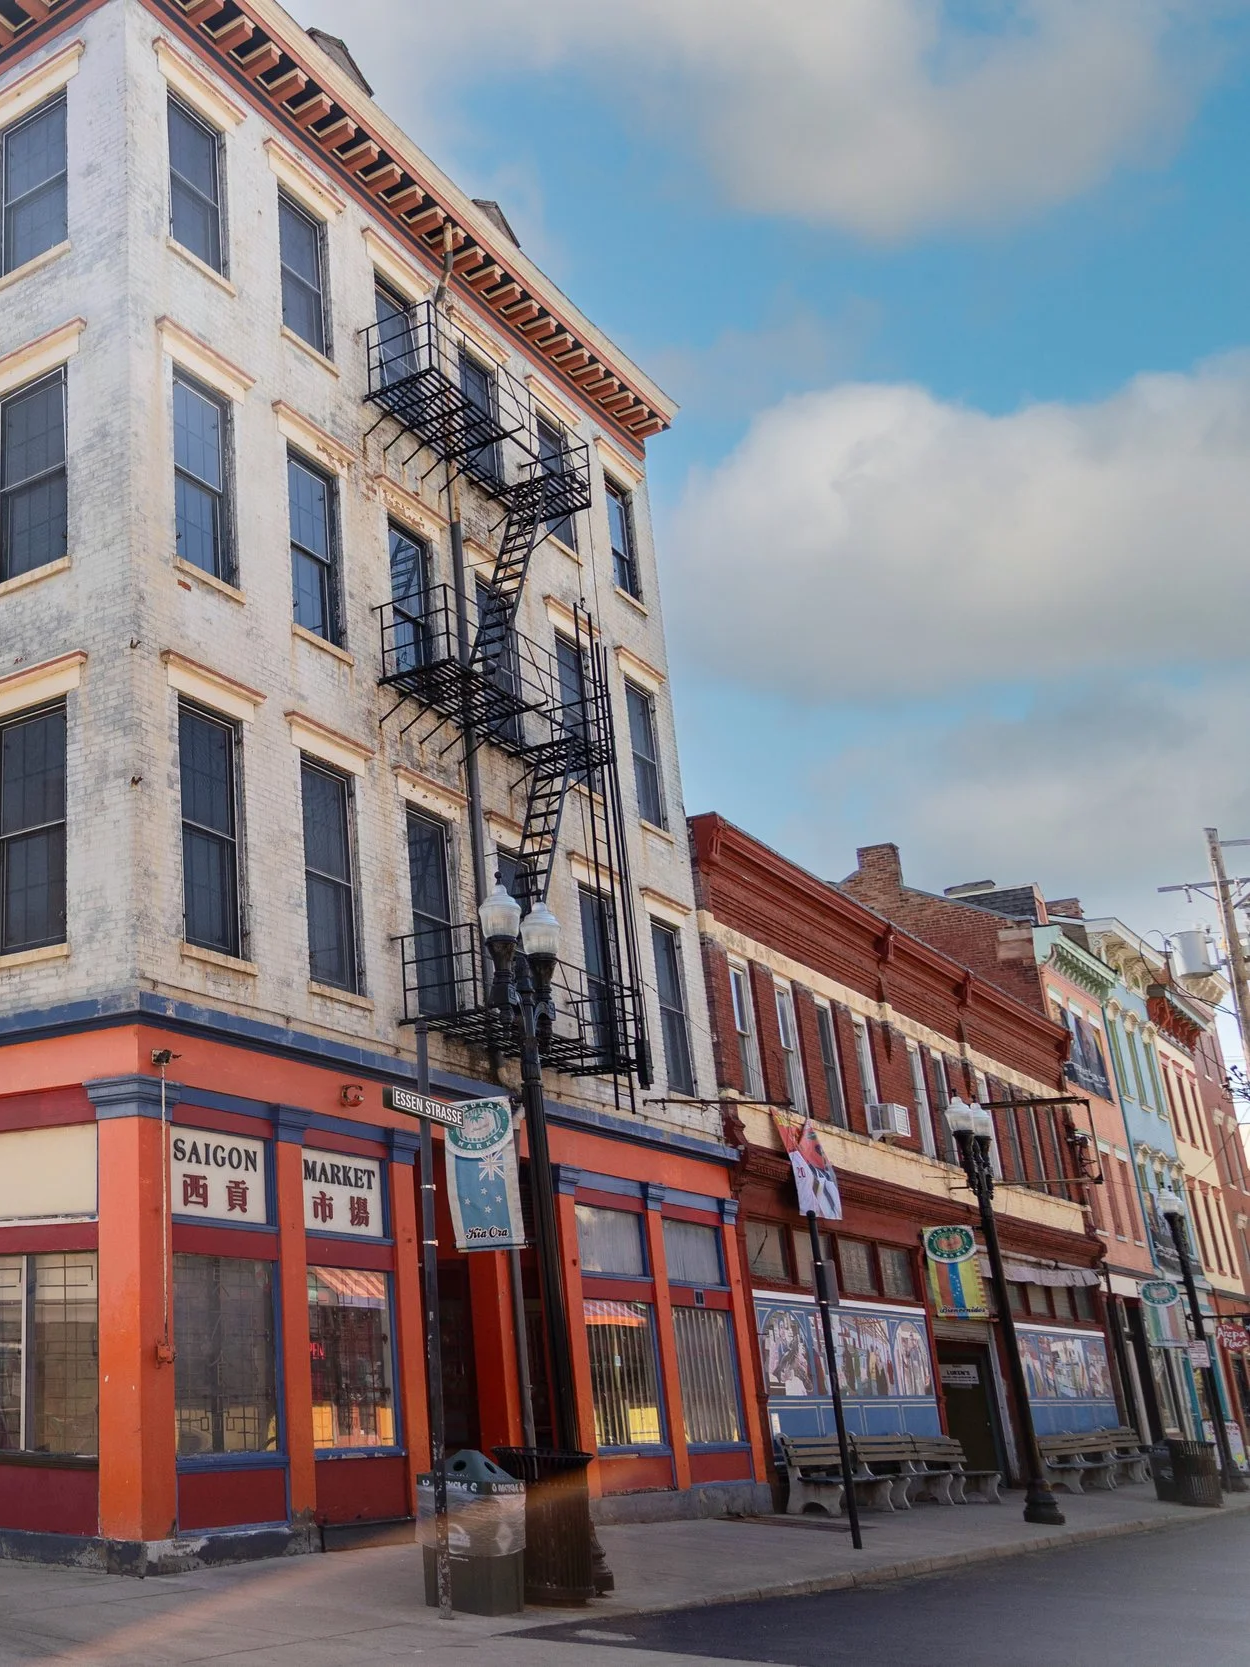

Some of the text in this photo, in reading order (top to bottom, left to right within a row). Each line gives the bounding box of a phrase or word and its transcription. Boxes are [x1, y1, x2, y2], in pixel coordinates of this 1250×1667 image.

[395, 1090, 463, 1125] ESSEN STRASSE
[458, 1128, 504, 1149] MARKET
[173, 1138, 258, 1172] SAIGON
[303, 1158, 376, 1190] MARKET
[182, 1173, 250, 1214] 西貢
[465, 1225, 509, 1240] Kia Ora
[1216, 1327, 1246, 1340] Arepa
[1224, 1337, 1248, 1349] Place
